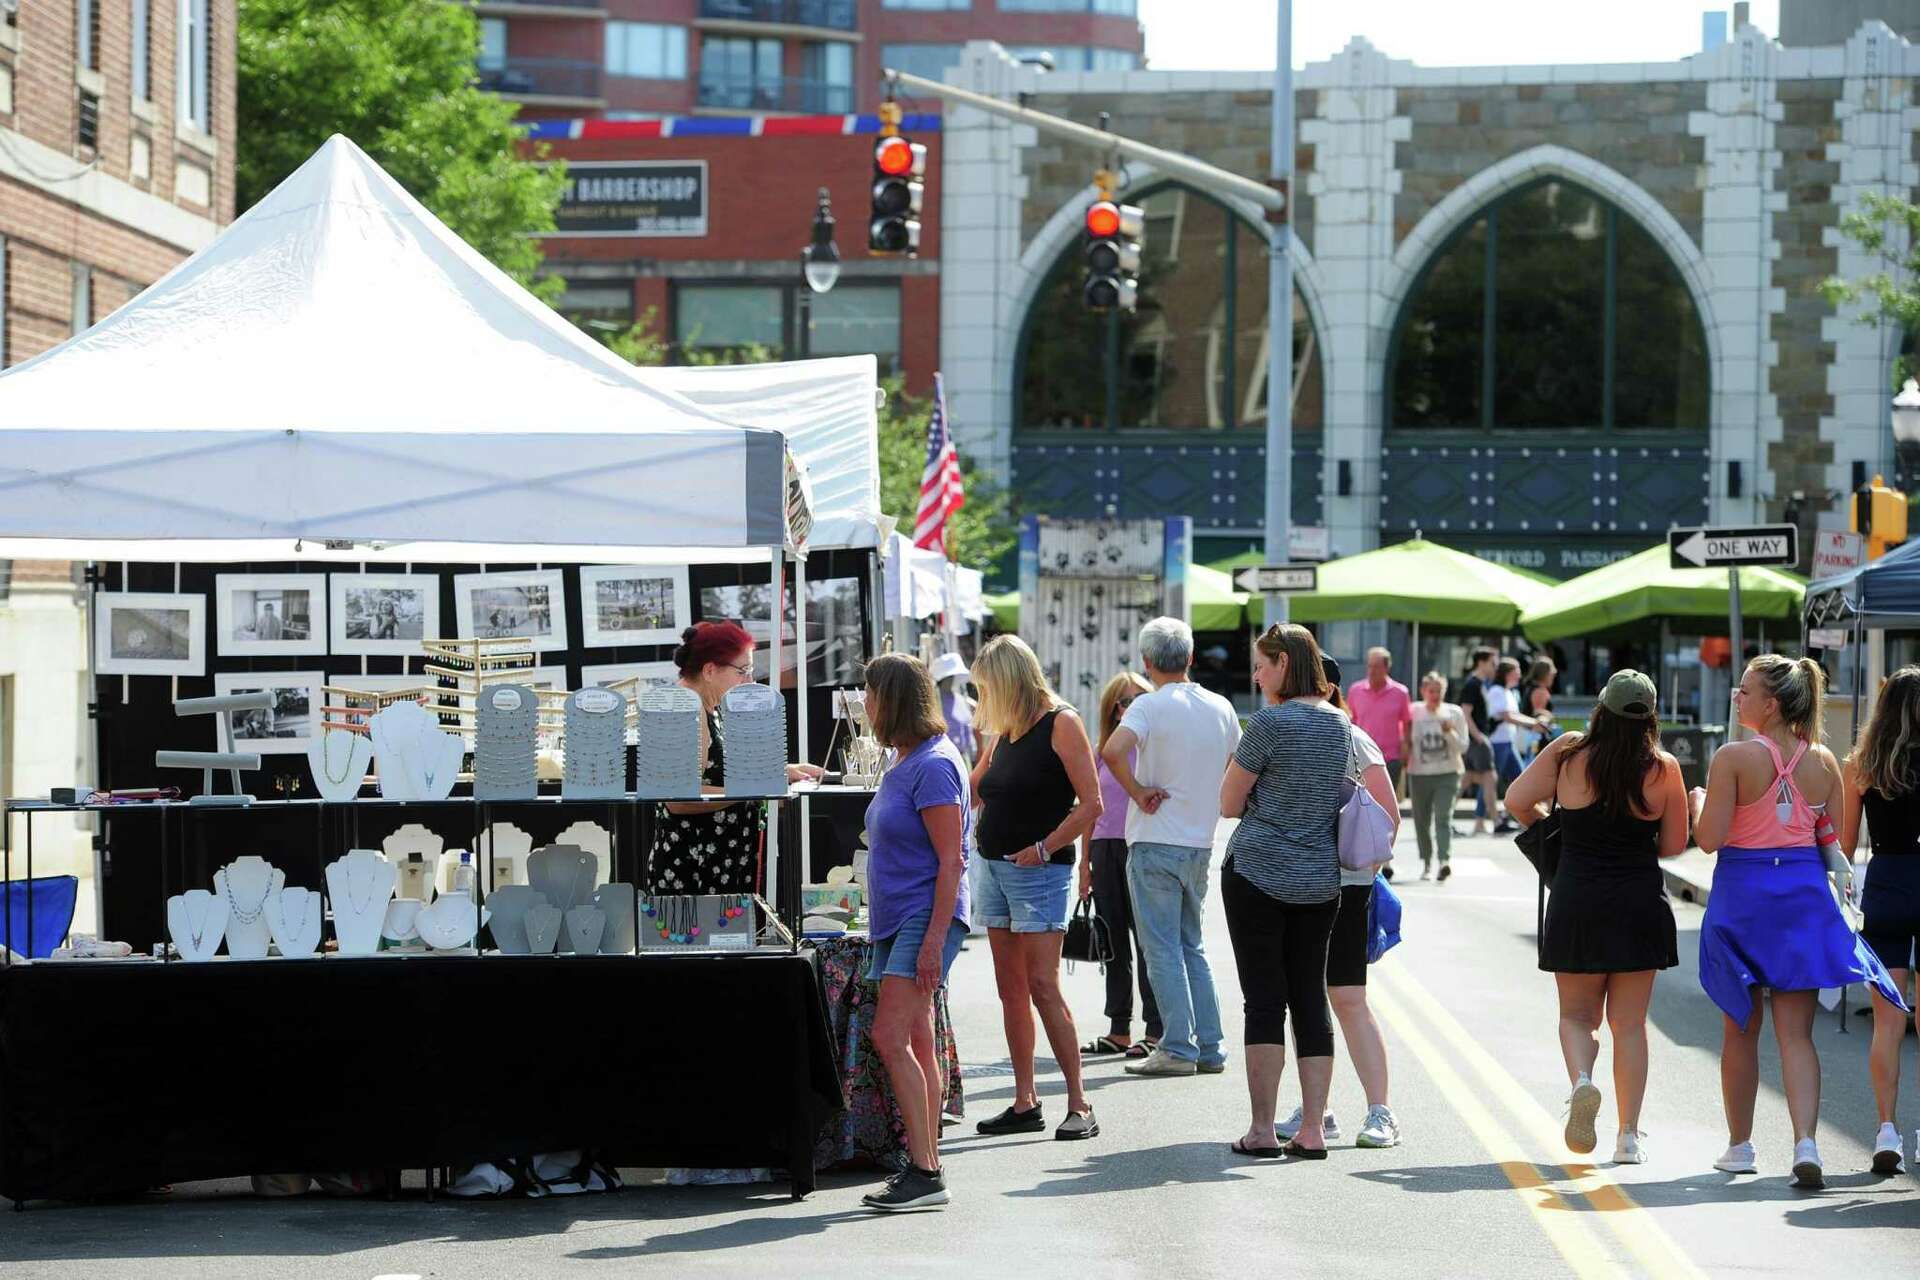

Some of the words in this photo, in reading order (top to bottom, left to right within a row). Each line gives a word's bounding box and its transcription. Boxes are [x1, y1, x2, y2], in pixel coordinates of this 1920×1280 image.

[578, 177, 697, 201] BARBERSHOP
[1707, 541, 1741, 556] ONE
[1747, 539, 1782, 554] WAY
[1832, 533, 1846, 548] NO
[1815, 552, 1857, 567] PARKING
